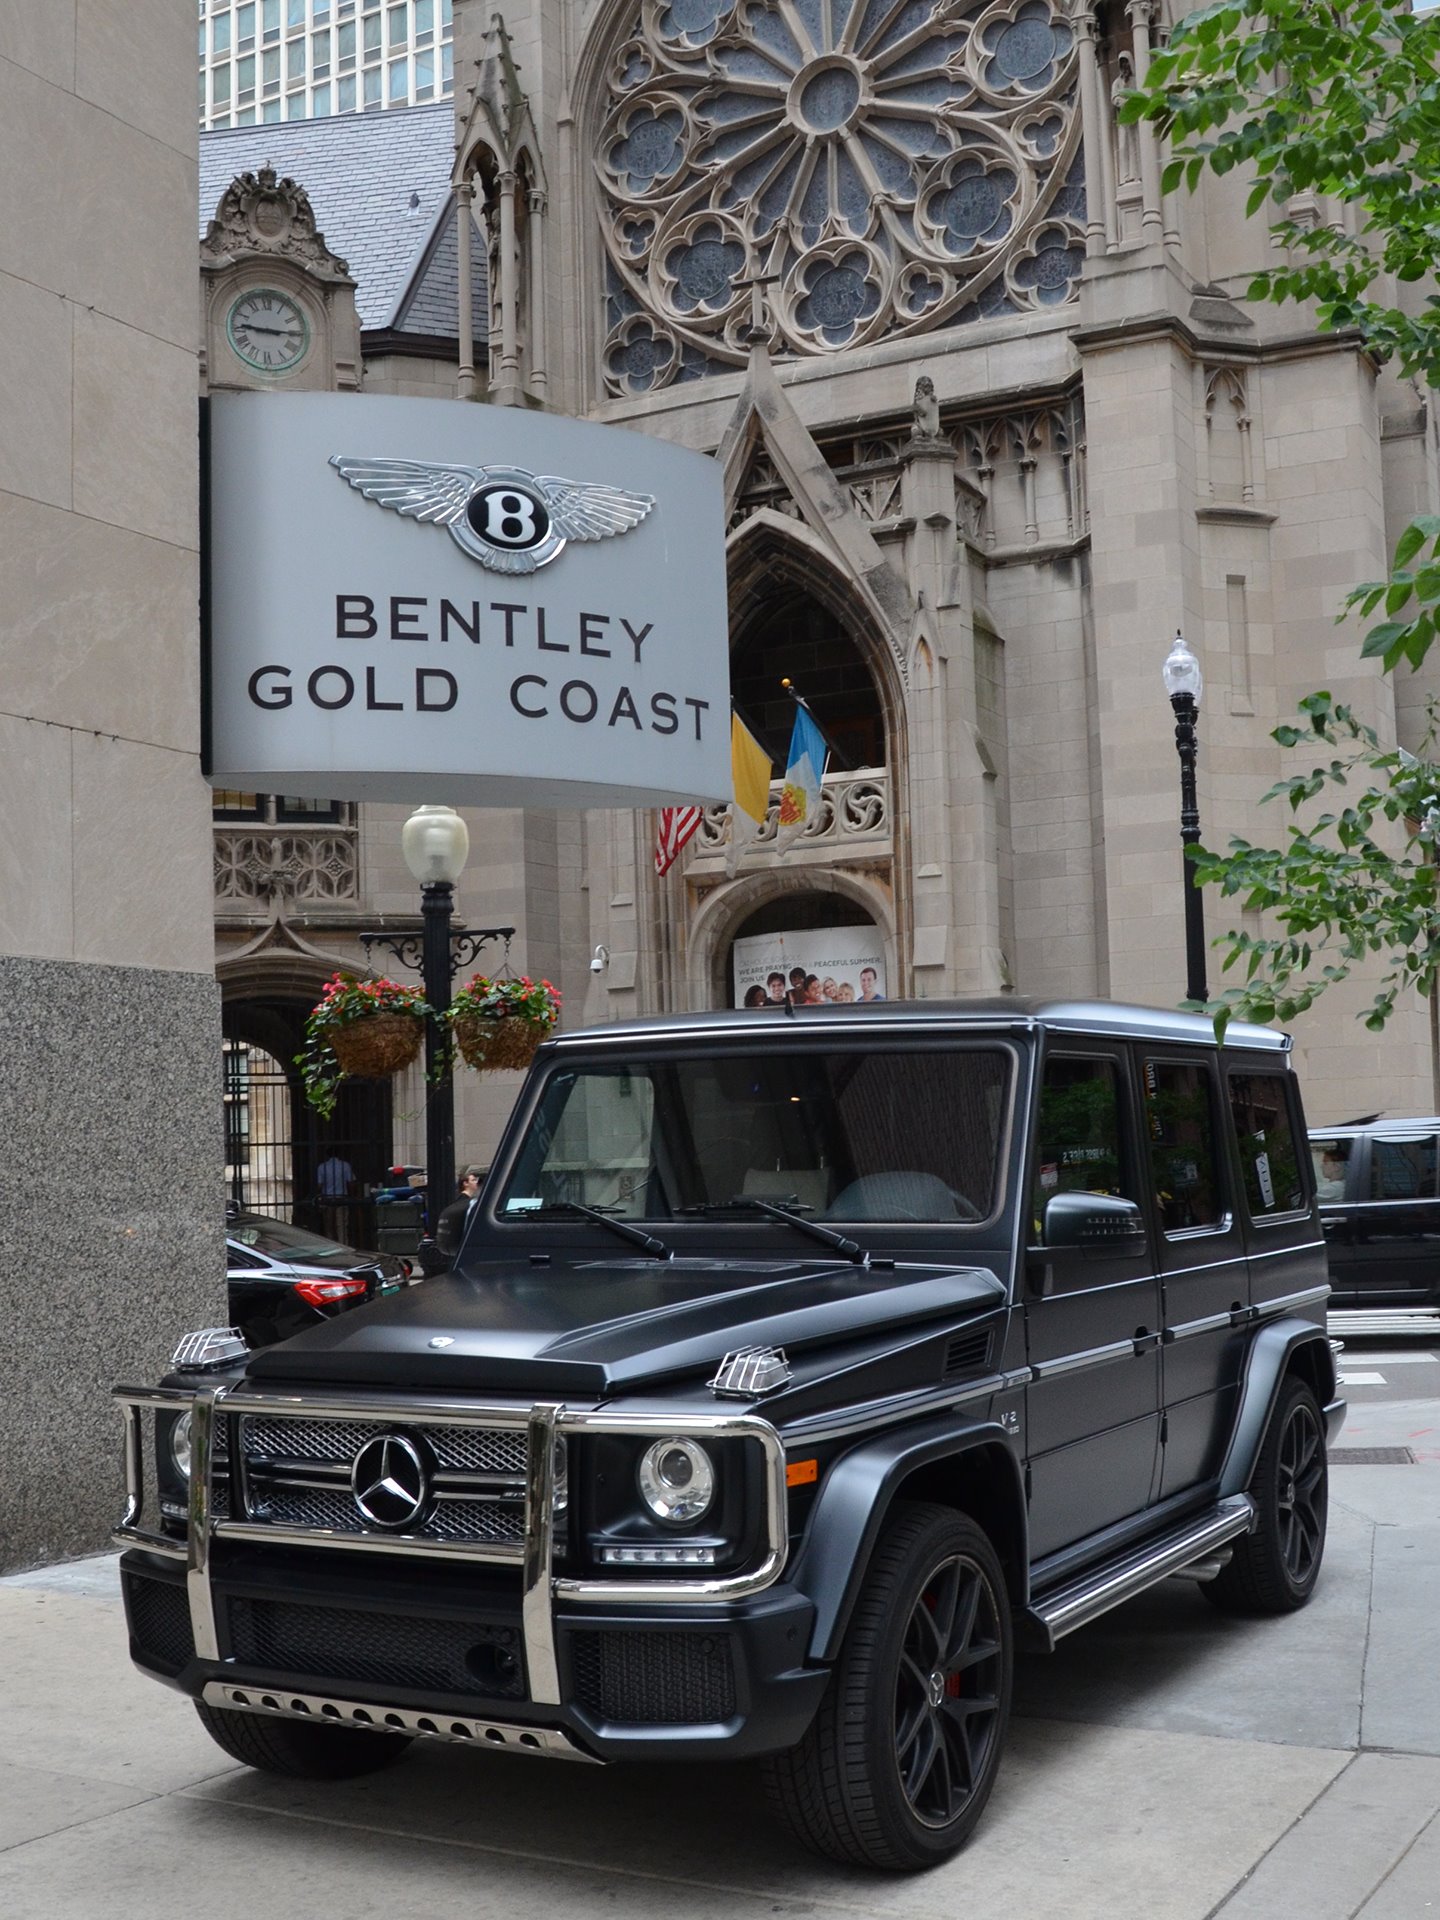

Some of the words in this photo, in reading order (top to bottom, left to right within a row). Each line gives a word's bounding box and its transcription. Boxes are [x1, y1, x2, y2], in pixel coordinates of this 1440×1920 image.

[484, 490, 537, 543] B
[335, 594, 654, 664] BENTLEY
[247, 664, 459, 713] GOLD
[509, 674, 710, 742] COAST
[738, 967, 750, 976] WE
[751, 966, 763, 974] ARE
[814, 959, 849, 968] PEACEFUL
[740, 976, 755, 984] JOIN
